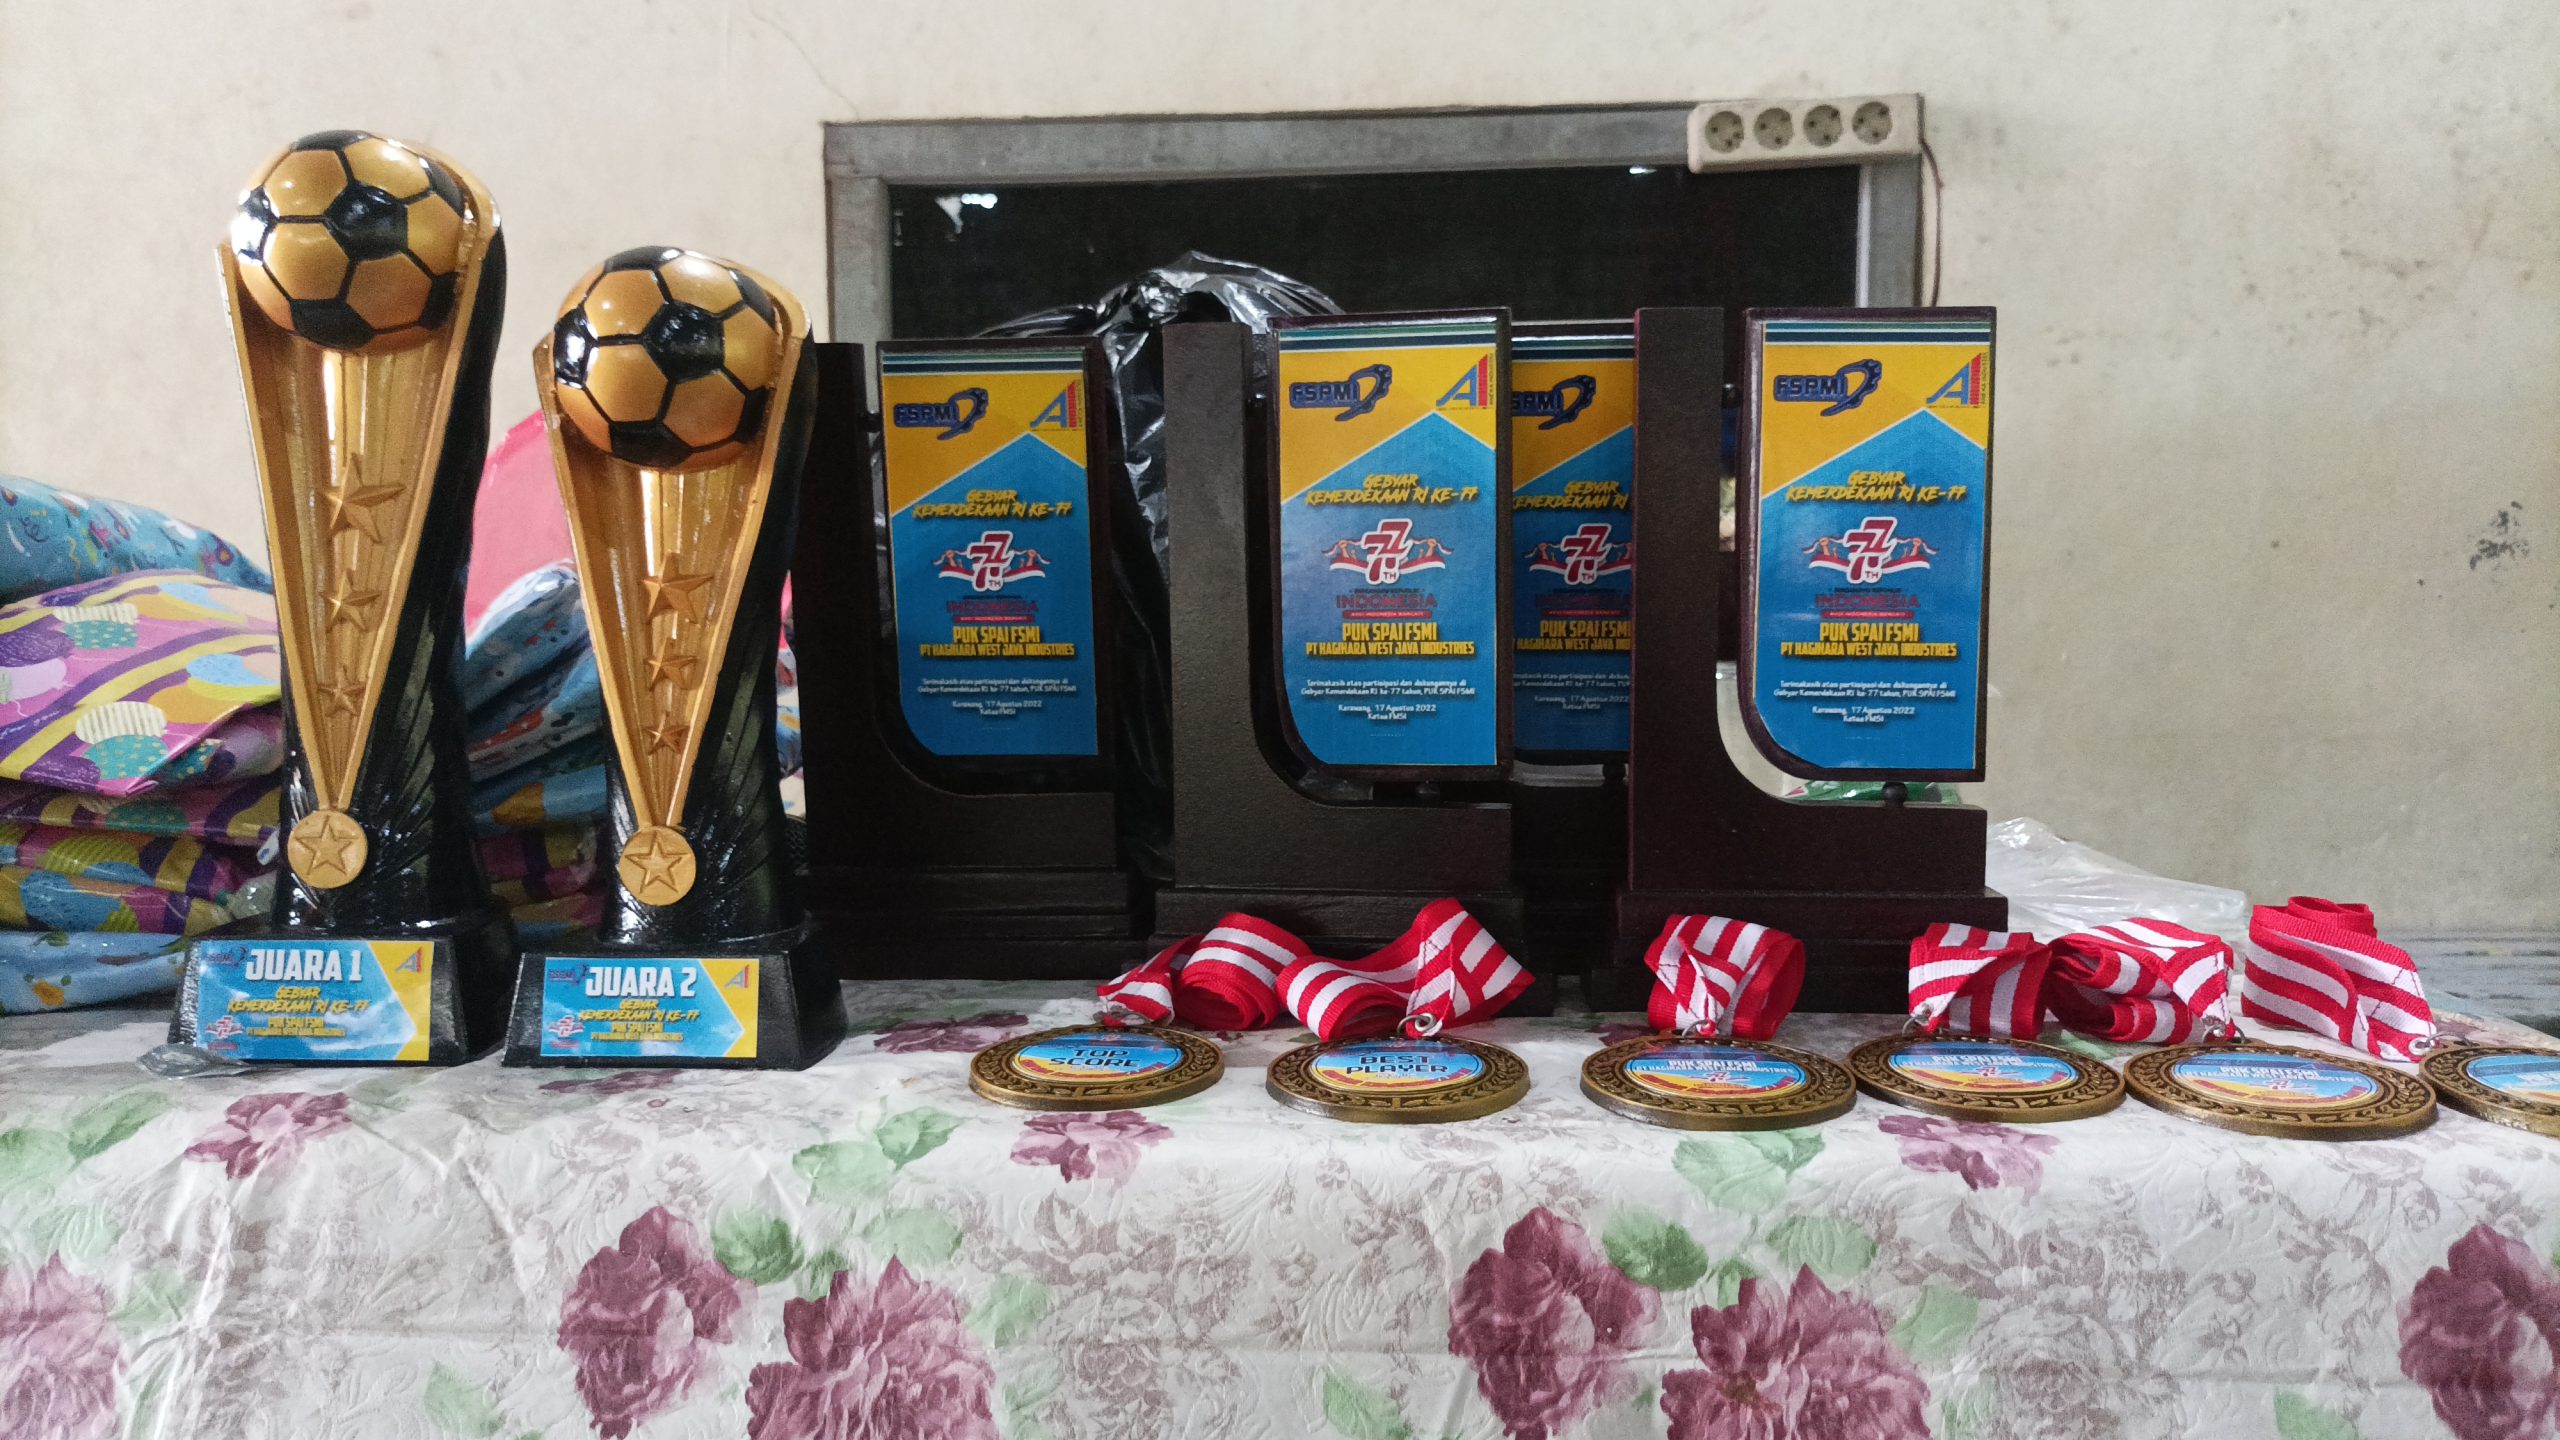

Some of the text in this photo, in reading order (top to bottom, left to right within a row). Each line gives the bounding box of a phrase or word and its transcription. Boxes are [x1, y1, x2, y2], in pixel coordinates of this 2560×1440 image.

[1292, 383, 1358, 402] FSPMI
[1776, 376, 1846, 399] FSPMI
[1512, 392, 1562, 413] SPMI
[895, 404, 959, 425] FSPMI
[1363, 473, 1419, 489] GEBYAR
[1848, 470, 1906, 486] GEBYAR
[966, 489, 1018, 503] GEBYAR
[1306, 488, 1410, 505] KEMERDEKAAN
[1786, 486, 1897, 502] KEMERDEKAAN
[912, 501, 1010, 518] KEMERDEKAAN
[953, 626, 1040, 643] PUK SPAI FSMI
[1342, 622, 1437, 641] PUK SPAI FSMI
[1540, 620, 1567, 638] PUK
[1569, 620, 1599, 638] SPAI
[1819, 622, 1919, 641] PUK SPAI FSMI
[920, 643, 931, 656] PT
[978, 643, 1000, 656] WEST
[1002, 643, 1025, 656] JAVA
[1306, 641, 1317, 655] PT
[1368, 641, 1393, 655] WEST
[1395, 641, 1419, 655] JAVA
[1420, 641, 1475, 655] INDUSTRIES
[1780, 642, 1793, 656] PT
[1846, 642, 1873, 656] WEST
[1874, 642, 1899, 656] JAVA
[1901, 642, 1957, 656] INDUSTRIES
[245, 949, 362, 981] JUARA 1
[585, 966, 697, 997] JUARA 2
[1075, 1049, 1129, 1058] TOP
[1360, 1055, 1430, 1065] BEST
[1049, 1058, 1140, 1067] SCORE
[1346, 1064, 1448, 1074] PLAYER
